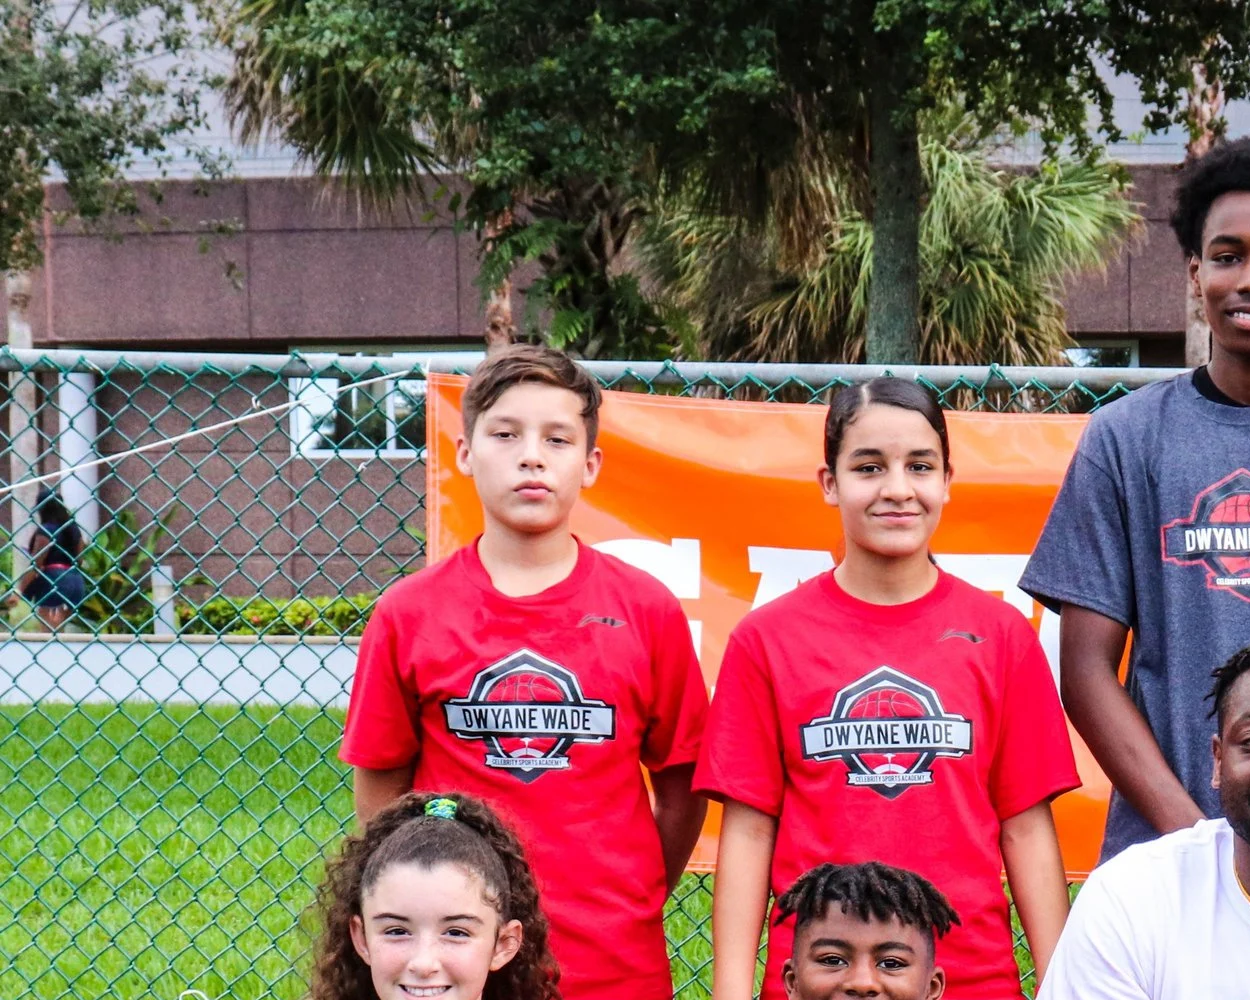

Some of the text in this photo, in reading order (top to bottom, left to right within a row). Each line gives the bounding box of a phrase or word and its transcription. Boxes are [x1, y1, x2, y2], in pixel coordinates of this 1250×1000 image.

[462, 708, 592, 731] DWYANE WADE
[824, 723, 953, 748] DWYANE WADE
